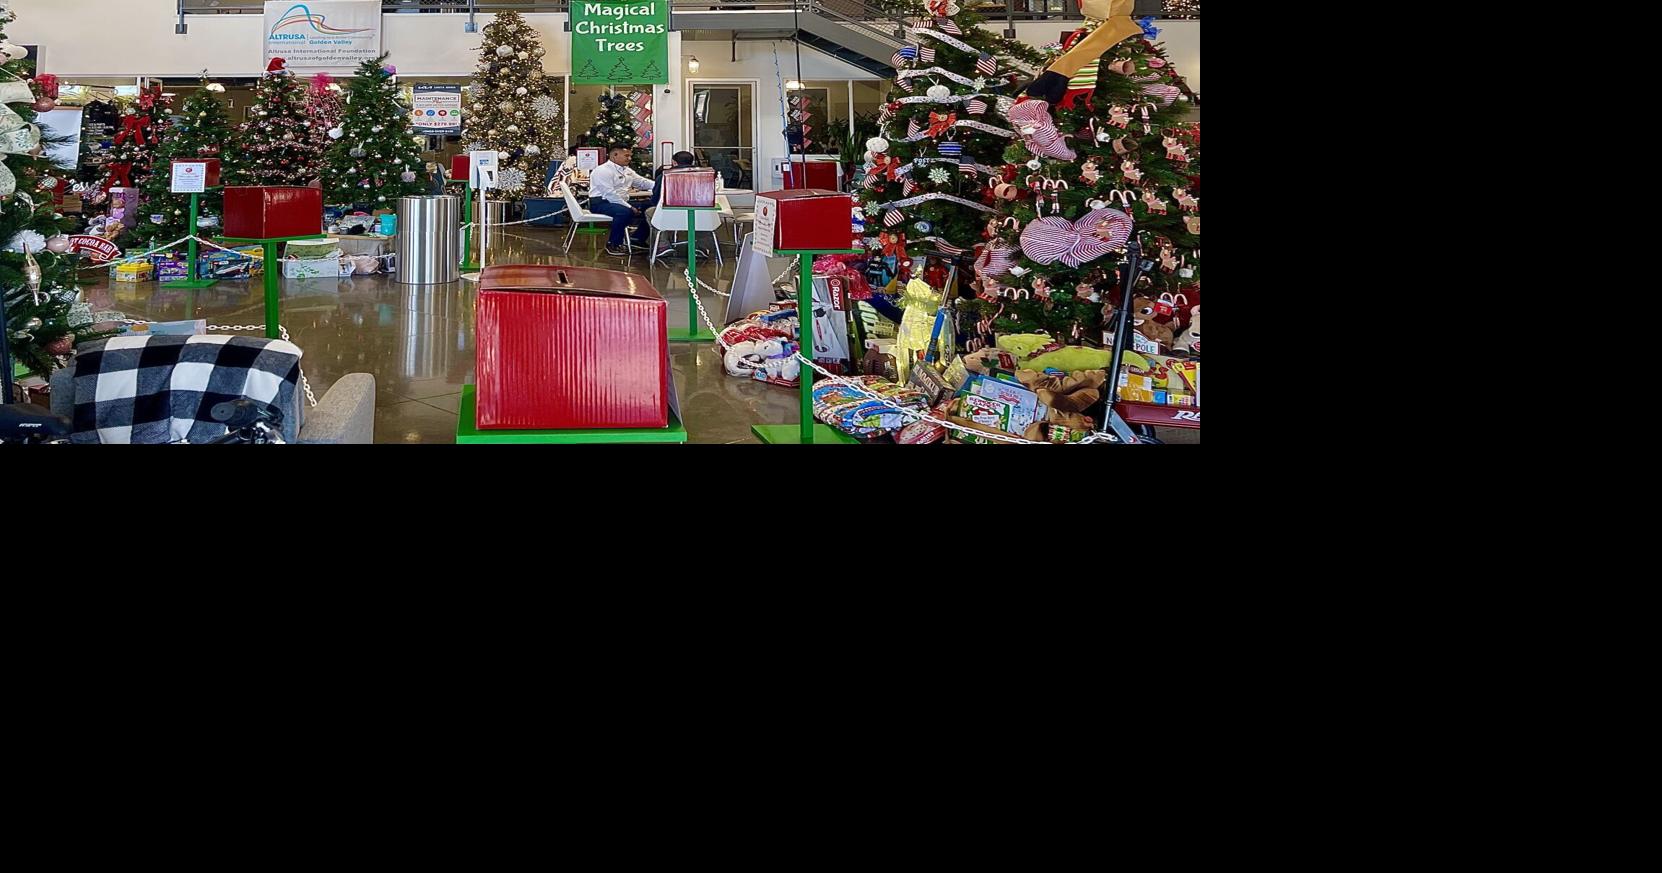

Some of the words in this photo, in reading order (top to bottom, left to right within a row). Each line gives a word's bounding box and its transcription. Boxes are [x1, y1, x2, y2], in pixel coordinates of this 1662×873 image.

[584, 2, 655, 20] Magical
[575, 21, 665, 34] Christmas
[595, 38, 644, 52] Trees
[78, 238, 100, 248] COCOA
[832, 286, 841, 310] Razor
[1136, 344, 1154, 353] POLE
